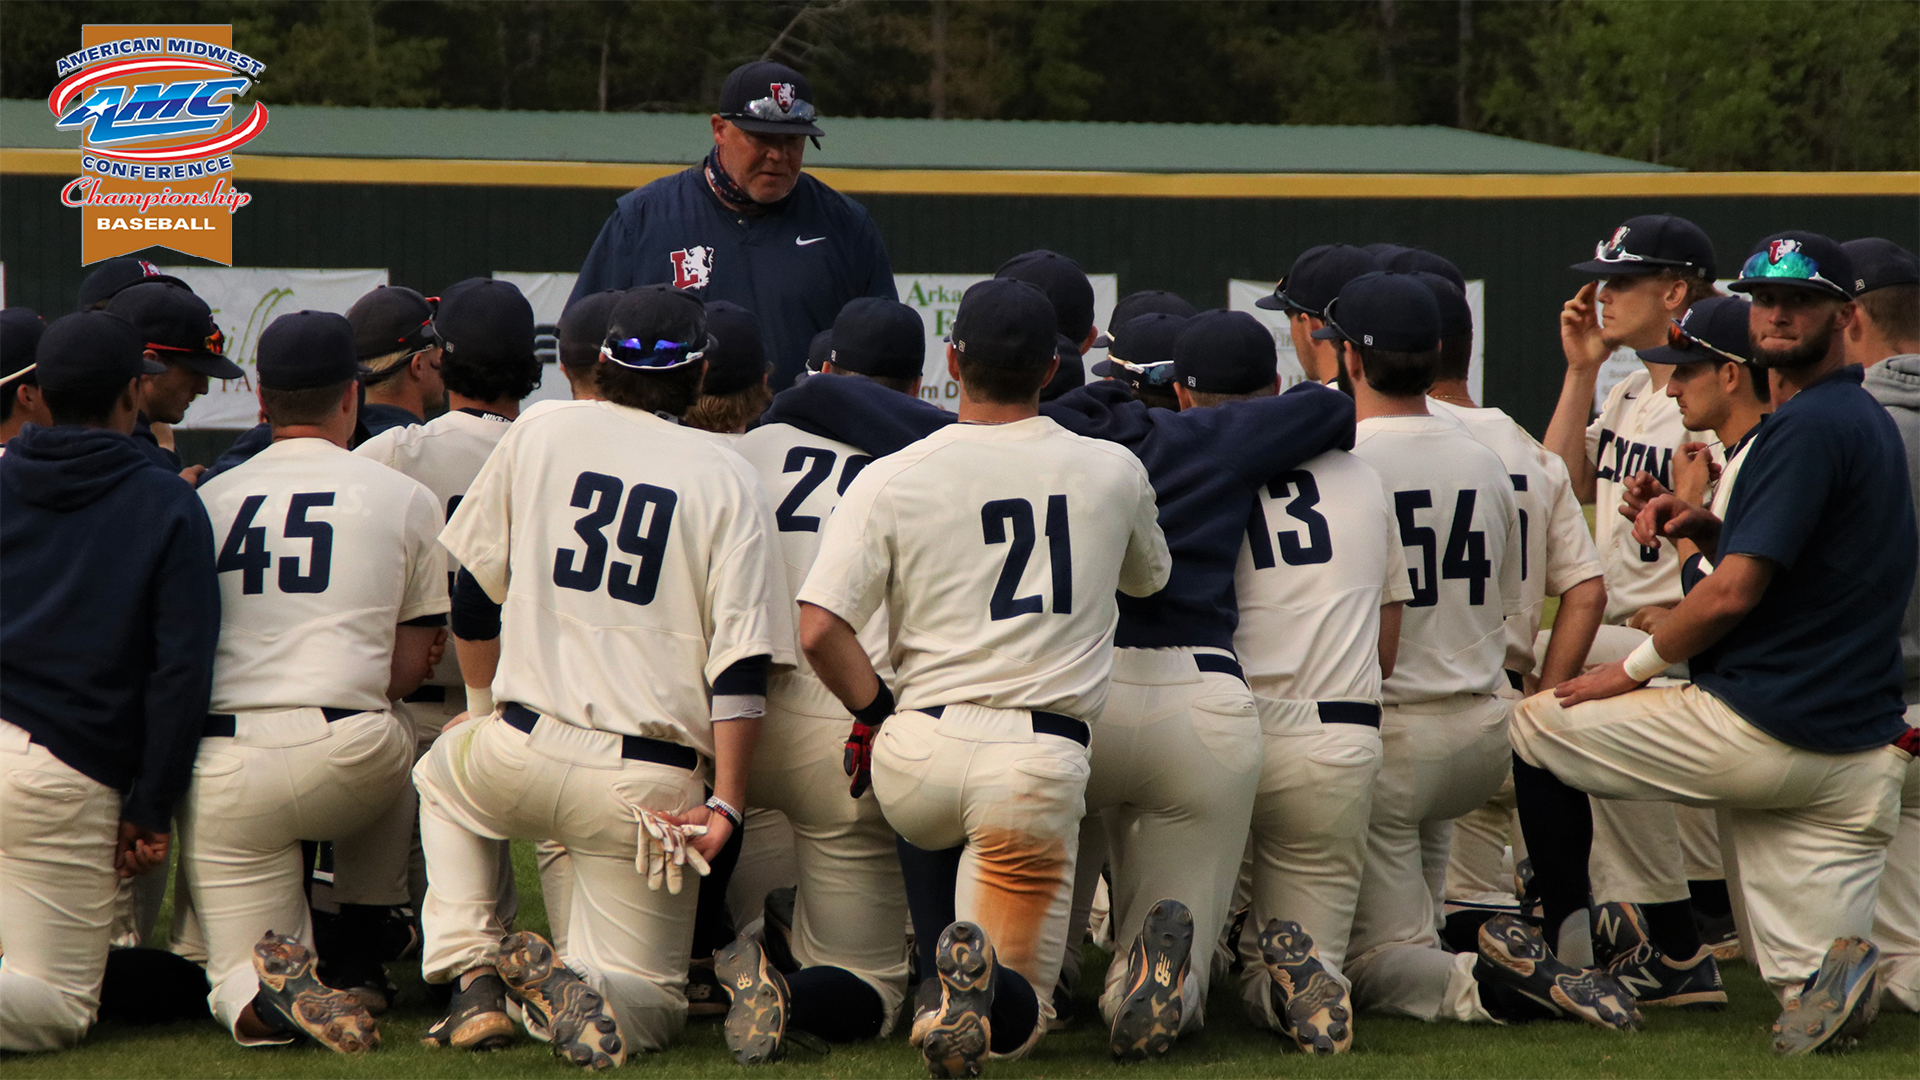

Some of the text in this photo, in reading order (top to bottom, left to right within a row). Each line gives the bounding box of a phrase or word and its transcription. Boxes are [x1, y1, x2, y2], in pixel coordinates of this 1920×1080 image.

[216, 491, 336, 595] 45
[552, 470, 678, 606] 39
[978, 494, 1072, 622] 21
[1246, 469, 1333, 571] 13
[1393, 489, 1492, 608] 54
